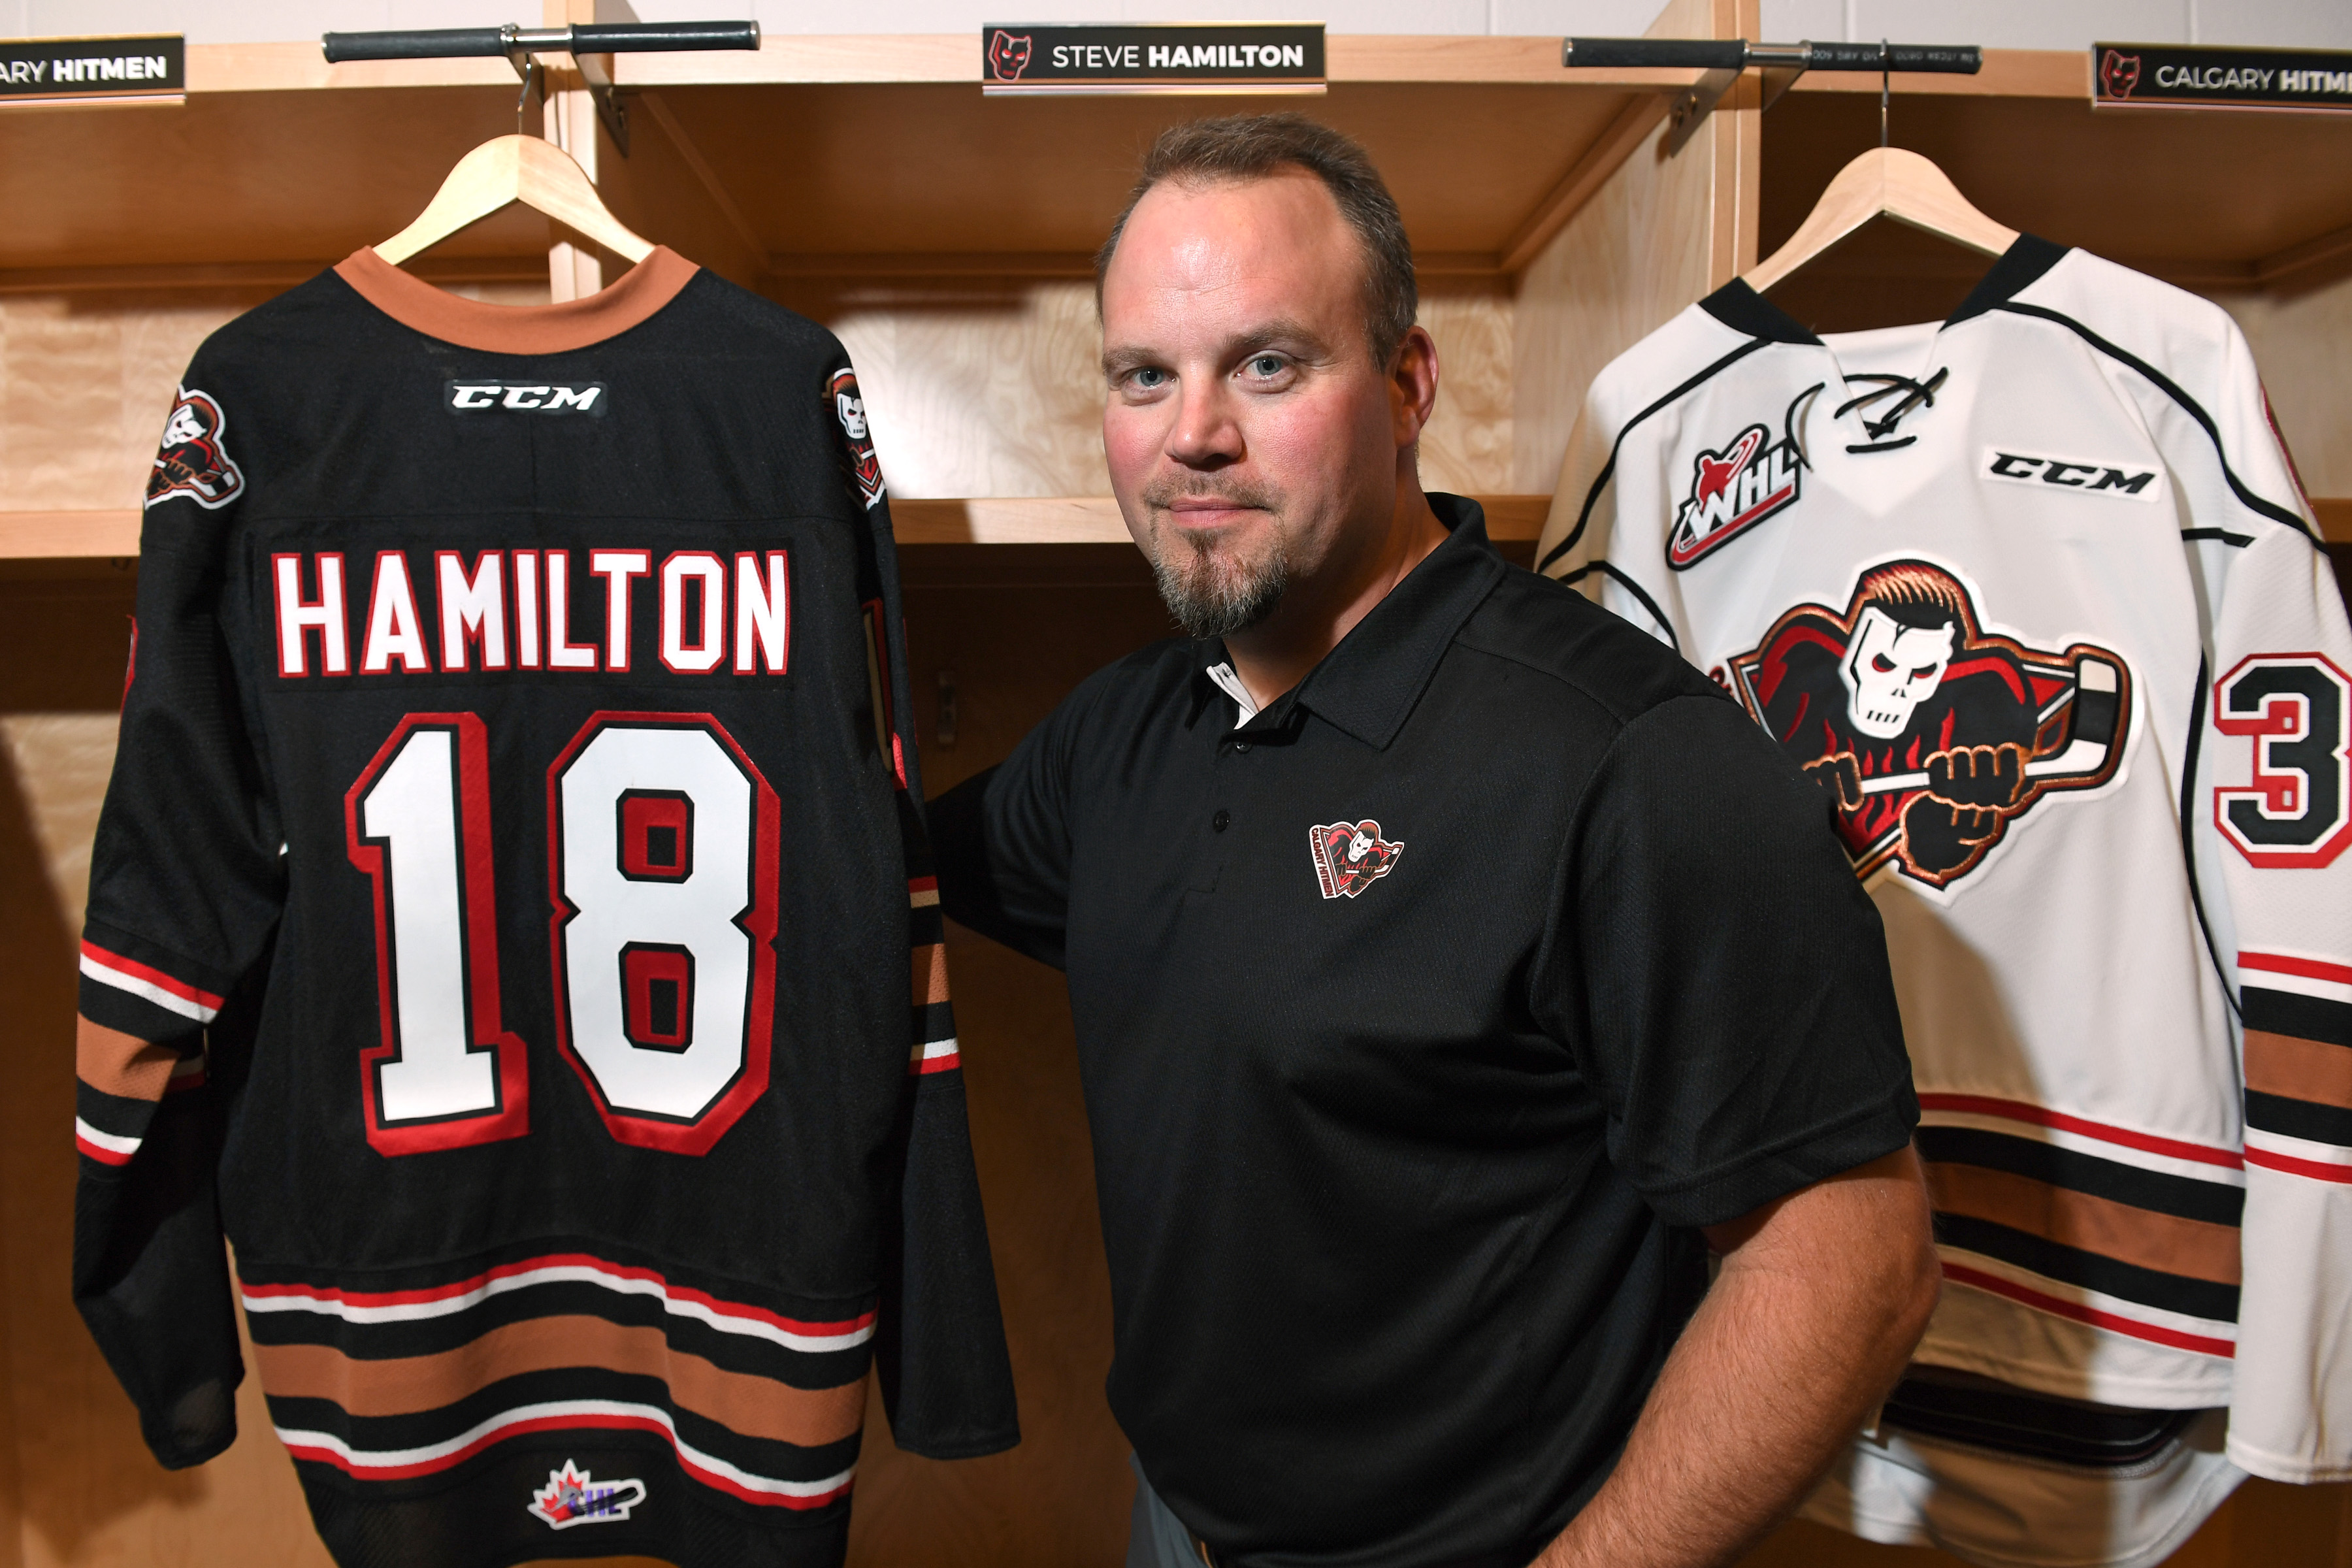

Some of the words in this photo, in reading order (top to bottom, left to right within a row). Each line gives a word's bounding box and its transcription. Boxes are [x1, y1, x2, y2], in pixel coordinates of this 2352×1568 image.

[53, 56, 167, 82] HITMEN
[1052, 44, 1139, 68] STEVE
[1148, 44, 1304, 68] HAMILTON
[2155, 65, 2274, 90] CALGARY
[2280, 69, 2352, 93] HITM
[451, 385, 601, 410] CCM
[1991, 452, 2155, 494] CCM
[1684, 446, 1795, 540] WHL
[270, 549, 790, 678] HAMILTON
[2214, 652, 2352, 868] 3
[1311, 828, 1327, 864] CALGARY
[1318, 866, 1334, 897] HITMEN
[344, 710, 780, 1158] 18
